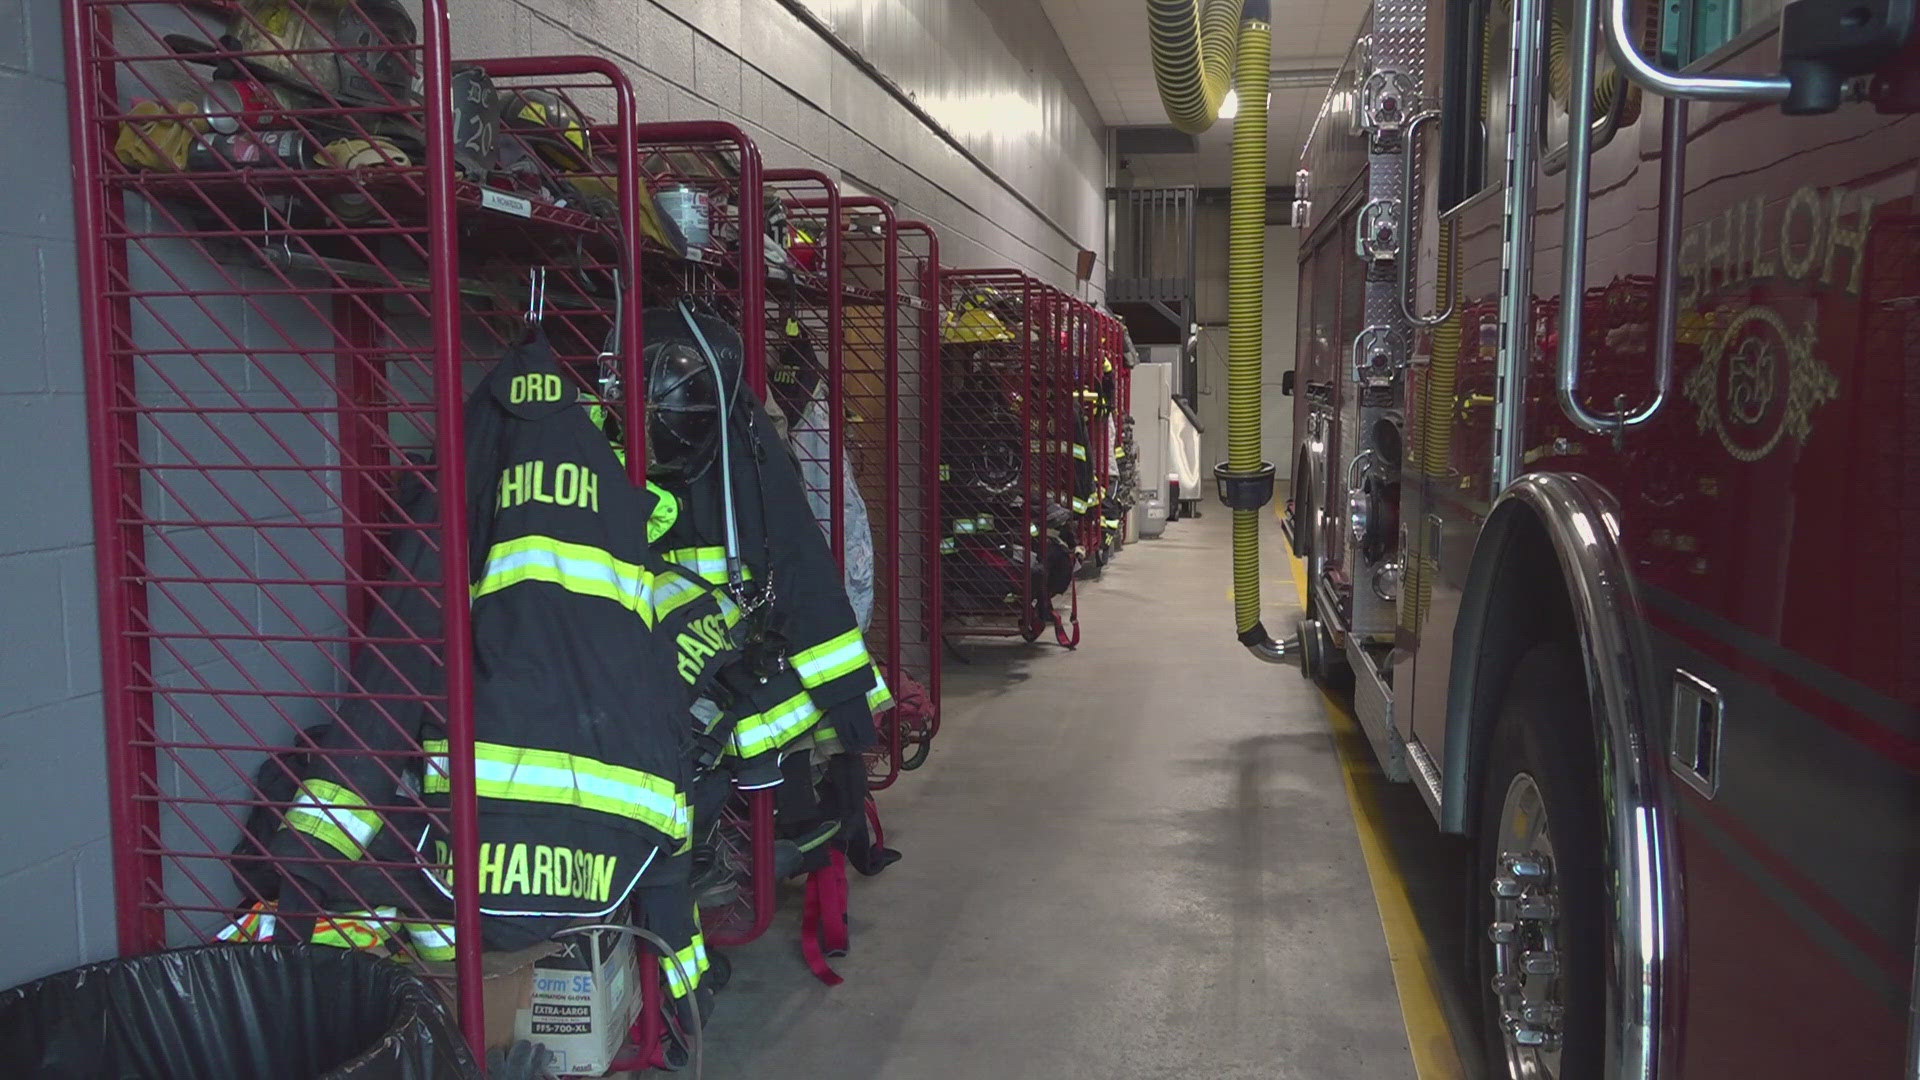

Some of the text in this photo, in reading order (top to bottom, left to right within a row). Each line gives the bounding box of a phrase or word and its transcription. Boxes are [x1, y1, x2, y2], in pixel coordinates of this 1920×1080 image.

[453, 107, 493, 157] 120
[1677, 185, 1876, 312] SHILOH
[510, 373, 562, 404] ORD
[494, 459, 599, 519] HILOH
[434, 840, 617, 903] RHARDSON
[533, 976, 566, 993] orm
[534, 1005, 588, 1017] EXTRA-LARGE
[536, 1023, 588, 1033] FFS-700-XL
